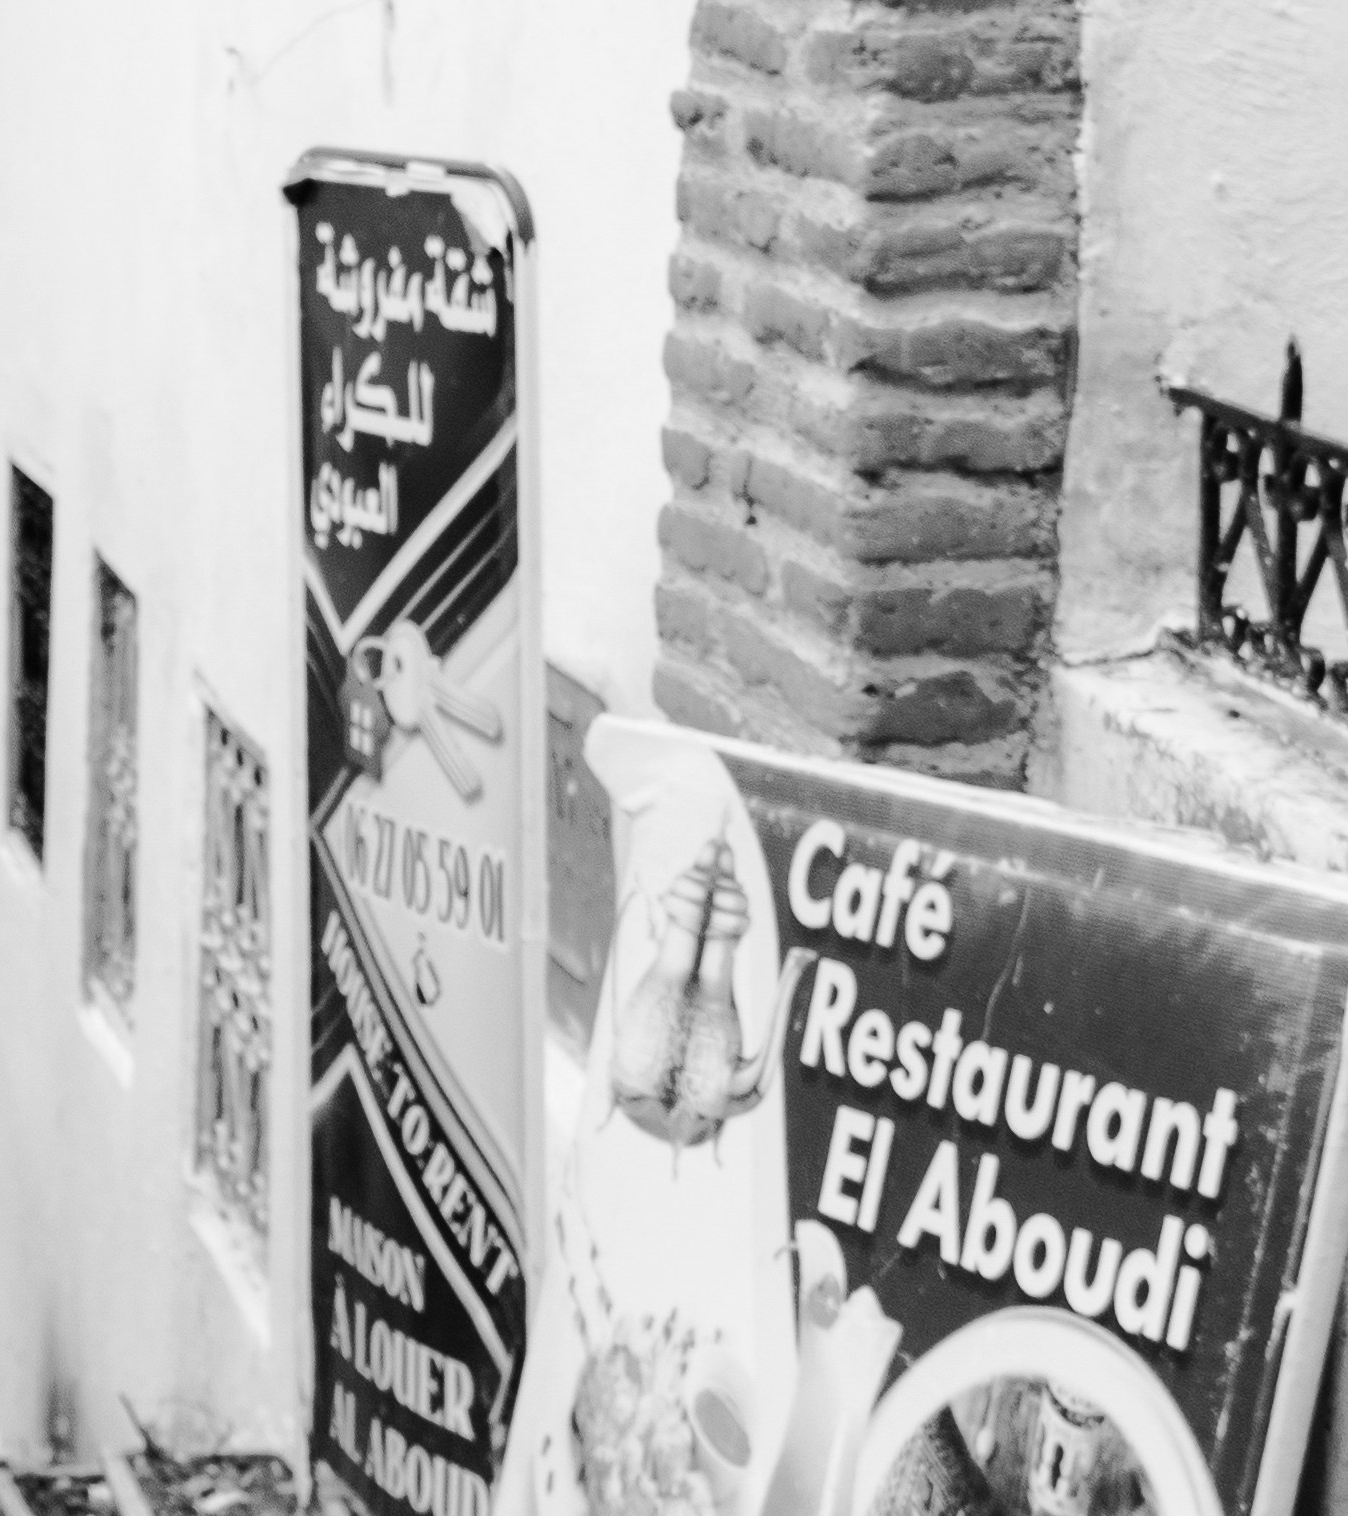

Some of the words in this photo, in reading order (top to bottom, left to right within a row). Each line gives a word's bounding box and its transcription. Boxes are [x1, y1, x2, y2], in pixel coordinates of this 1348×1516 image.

[402, 827, 432, 916] 05
[437, 837, 471, 930] 59
[786, 818, 954, 961] Café
[321, 910, 393, 1084] HOUSE
[387, 1064, 429, 1156] TO
[422, 1142, 521, 1296] RENT
[798, 956, 1239, 1200] Restaurant
[328, 1195, 425, 1314] MAISON
[816, 1104, 896, 1234] El
[896, 1138, 1208, 1352] Aboudi
[330, 1380, 363, 1465] AL
[354, 1301, 476, 1442] LOUER
